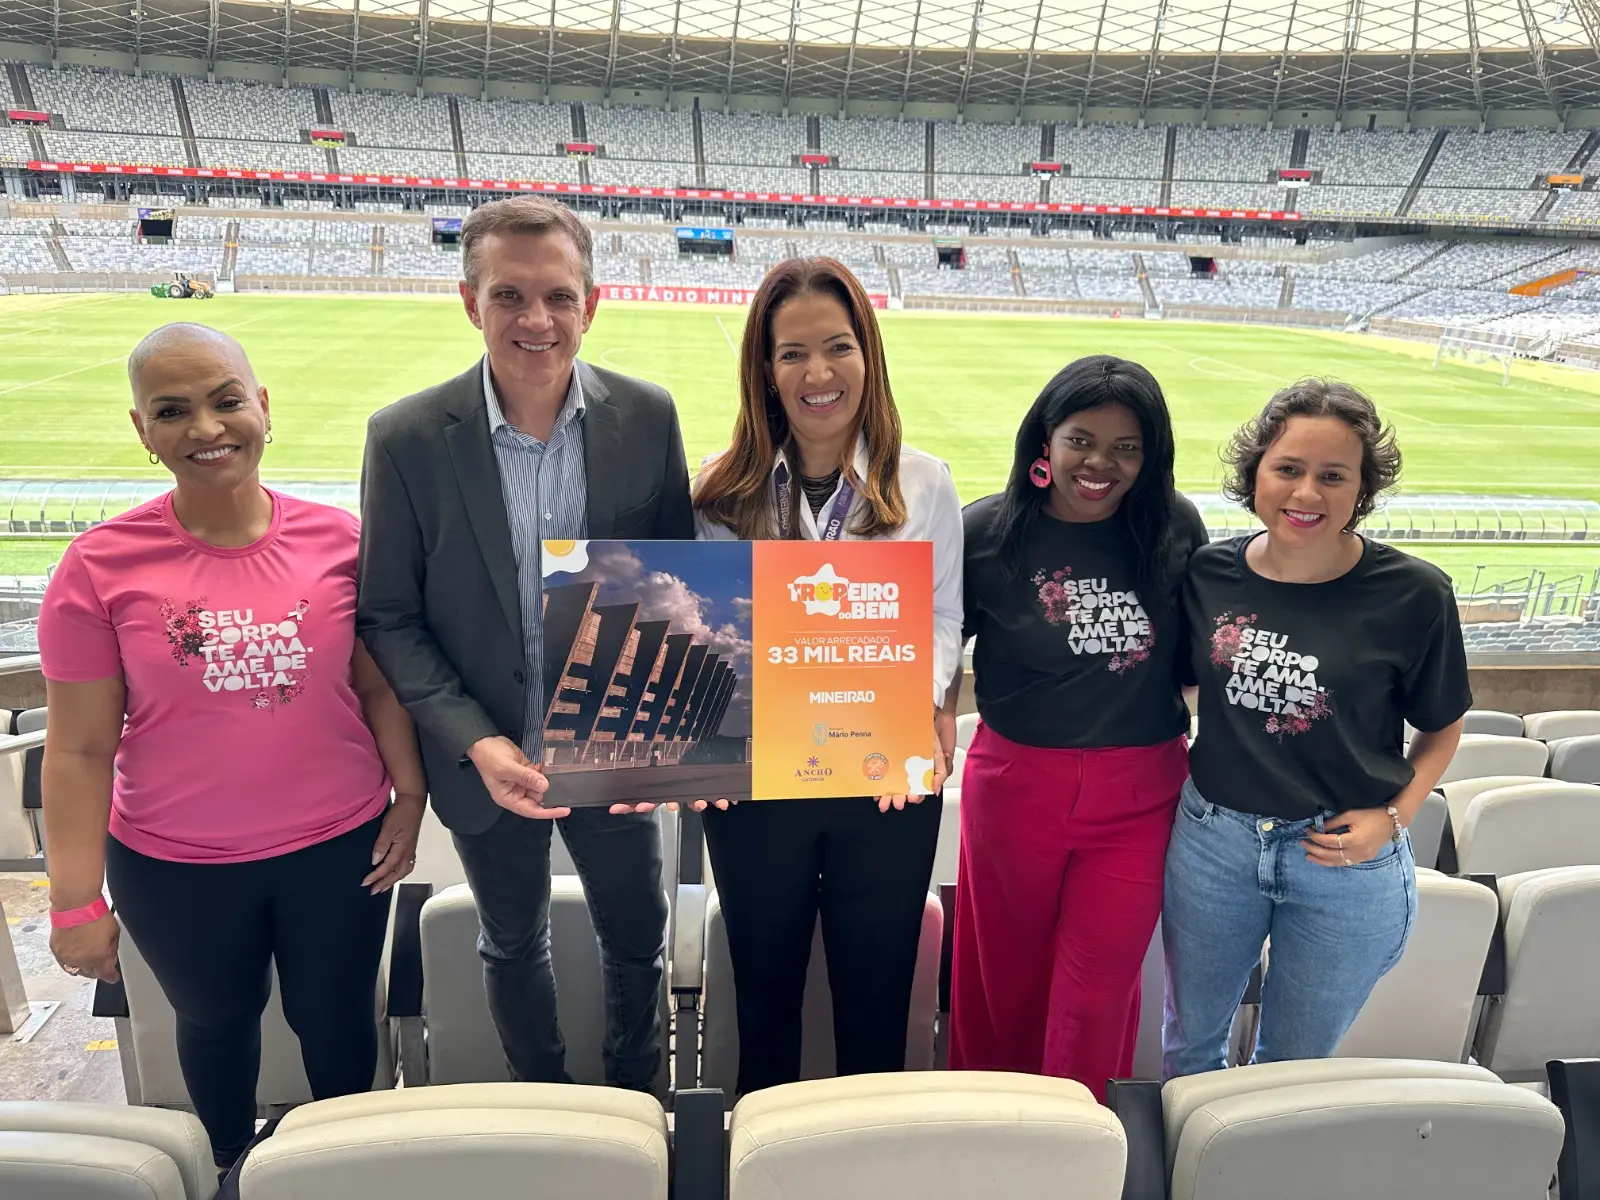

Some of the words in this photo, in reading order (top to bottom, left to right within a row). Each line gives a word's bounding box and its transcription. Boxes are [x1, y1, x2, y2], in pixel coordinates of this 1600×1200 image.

[609, 286, 698, 302] ESTÁDIO
[787, 582, 899, 602] TROPEIRO
[1063, 578, 1107, 595] SEU
[851, 601, 899, 619] BEM
[1067, 590, 1139, 610] CORPO
[198, 608, 253, 628] SEU
[1065, 609, 1094, 624] TE
[201, 620, 298, 645] CORPO
[1068, 621, 1118, 640] AME
[1123, 620, 1150, 636] DE
[1240, 628, 1289, 649] SEU
[794, 637, 827, 645] VALOR
[828, 636, 890, 645] ARRECADADO
[199, 644, 236, 663] TE
[767, 646, 798, 664] 33
[804, 646, 844, 663] MIL
[848, 644, 916, 662] REAIS
[1236, 643, 1319, 672] CORPO
[203, 657, 265, 679] AME
[273, 653, 307, 671] DE
[1230, 656, 1260, 677] TE
[1225, 673, 1280, 698] AME
[1284, 685, 1317, 706] DE
[828, 730, 848, 738] Mário
[794, 768, 833, 777] ANCHO
